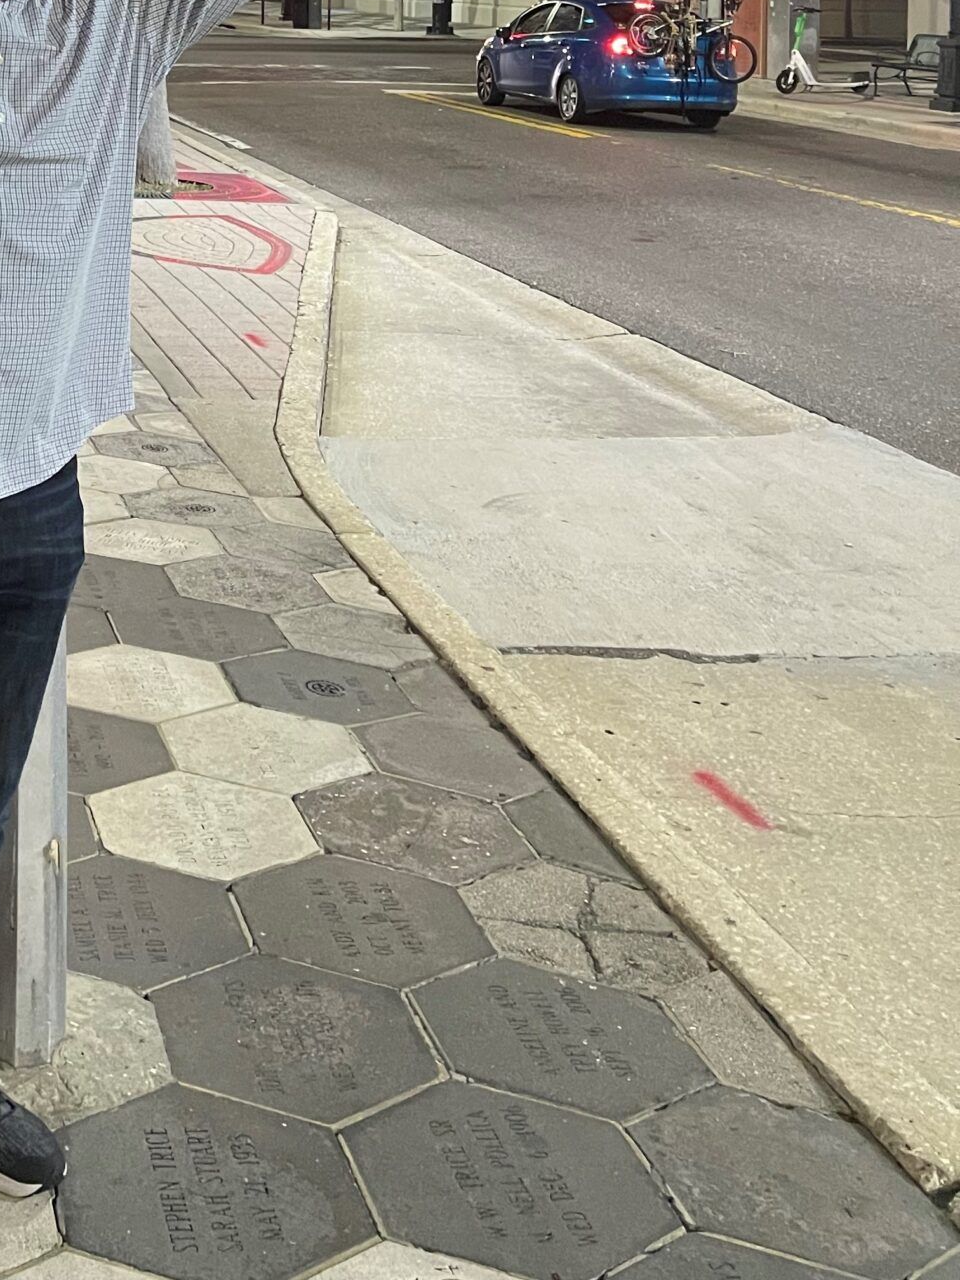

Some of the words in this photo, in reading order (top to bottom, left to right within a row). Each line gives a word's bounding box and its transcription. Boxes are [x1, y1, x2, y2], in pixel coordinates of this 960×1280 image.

[144, 1128, 177, 1171] TRICE
[184, 1127, 223, 1184] STUART
[157, 1181, 199, 1253] STEPHEN
[203, 1193, 244, 1252] SARAH
[249, 1206, 284, 1242] MAY
